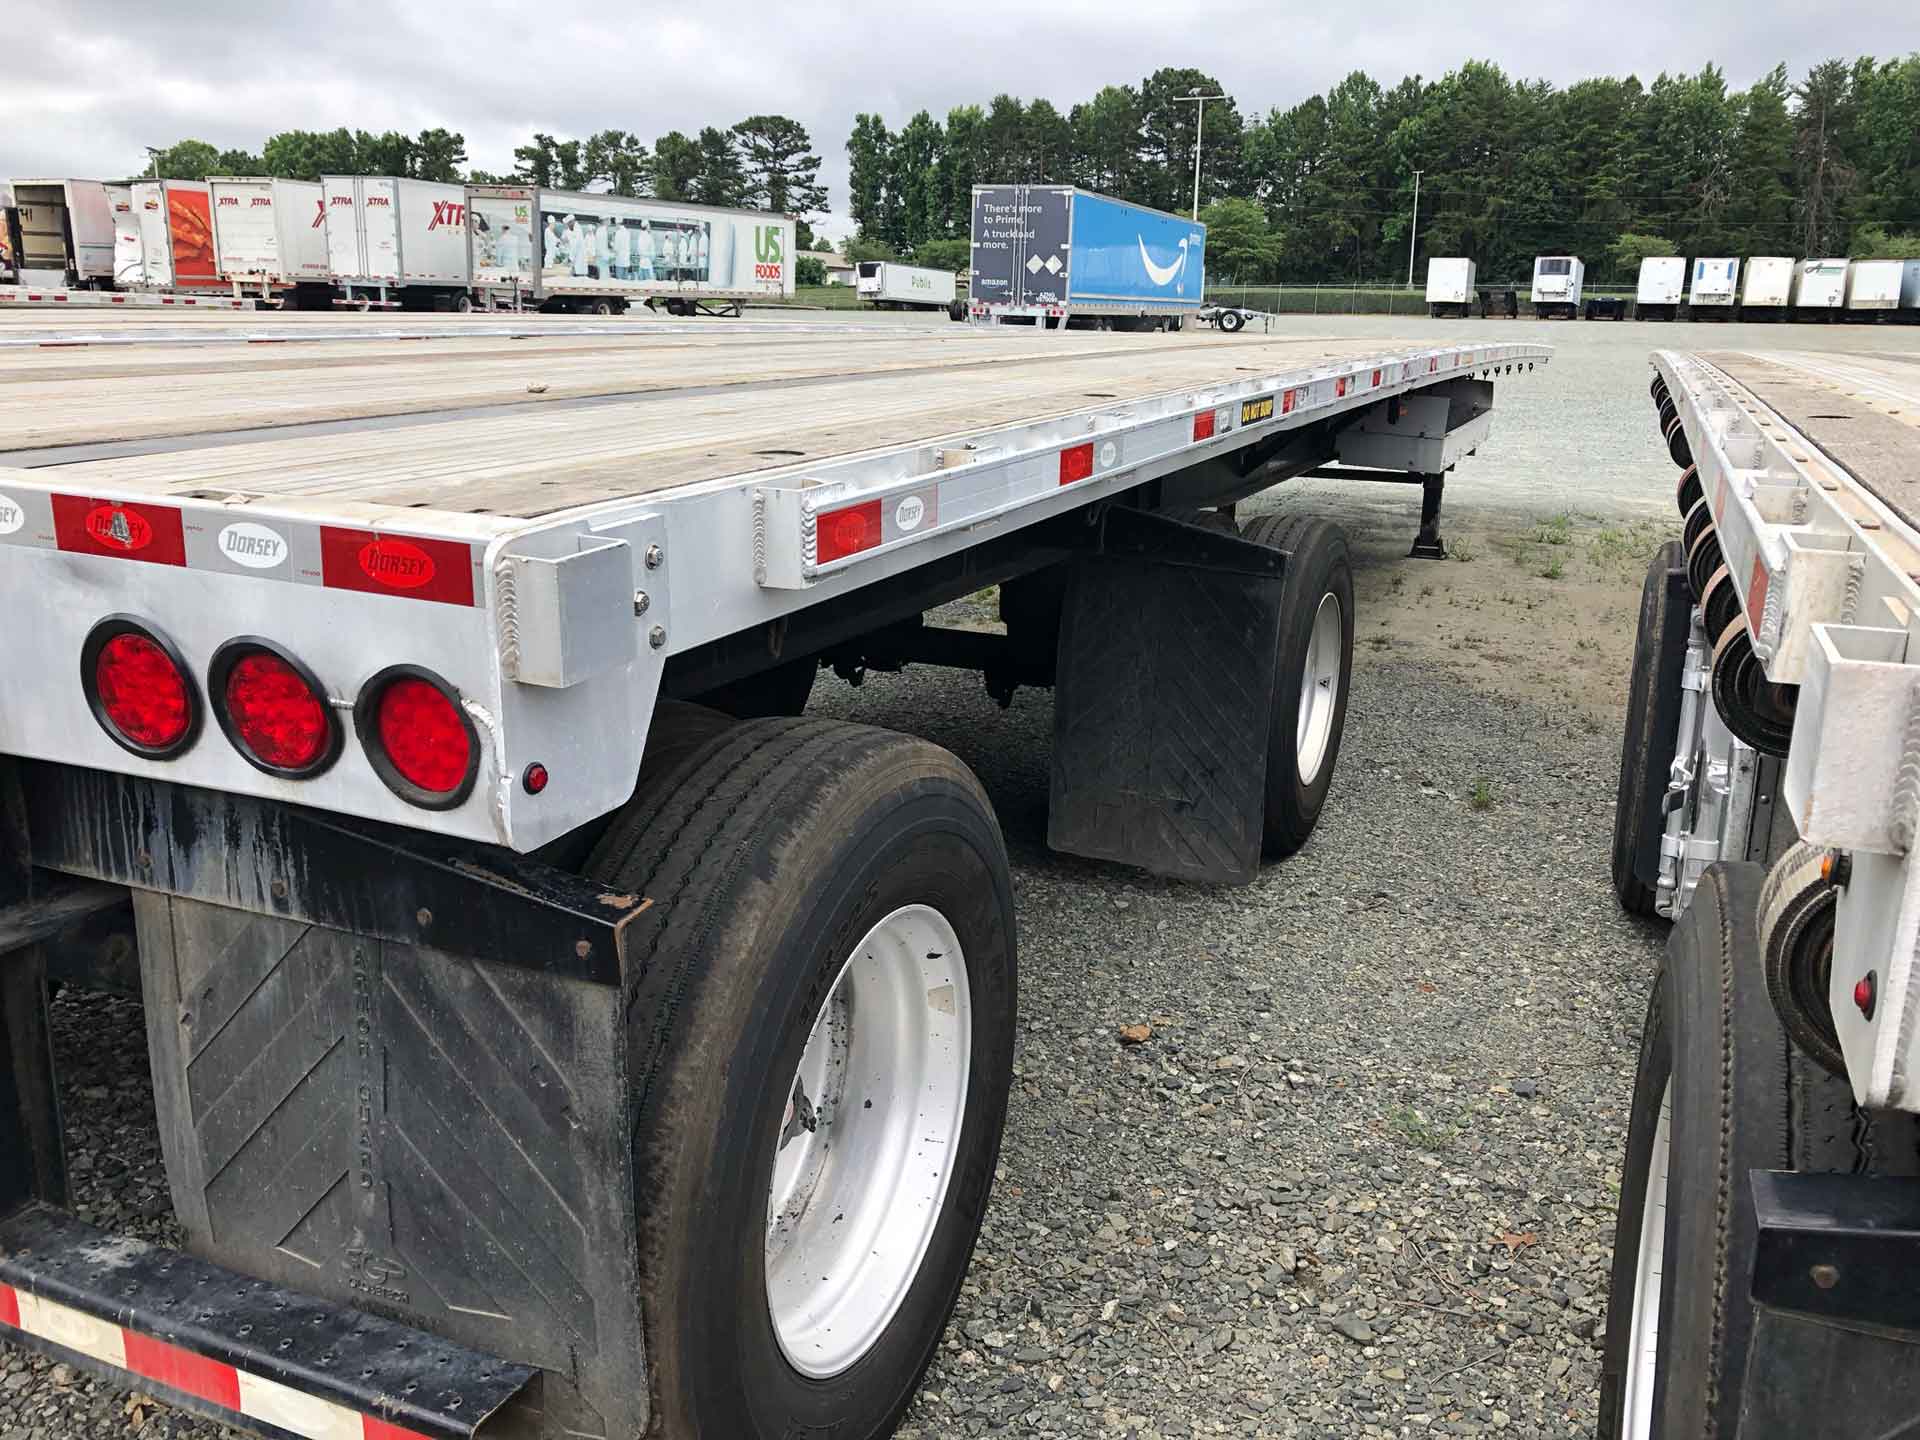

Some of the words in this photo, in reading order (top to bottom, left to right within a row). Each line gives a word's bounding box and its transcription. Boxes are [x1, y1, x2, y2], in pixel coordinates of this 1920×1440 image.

[218, 197, 239, 207] XTRA
[250, 197, 272, 207] XTRA
[330, 196, 353, 207] XTRA
[367, 197, 390, 207] XTRA
[984, 203, 1017, 213] There's
[1018, 205, 1043, 214] more
[983, 215, 993, 224] to
[983, 229, 990, 238] A
[992, 228, 1035, 239] truckload
[982, 241, 1009, 249] more.
[756, 265, 781, 279] FOODS
[981, 278, 1008, 286] amazon
[226, 530, 281, 557] DORSEY
[368, 549, 427, 577] DORSEY
